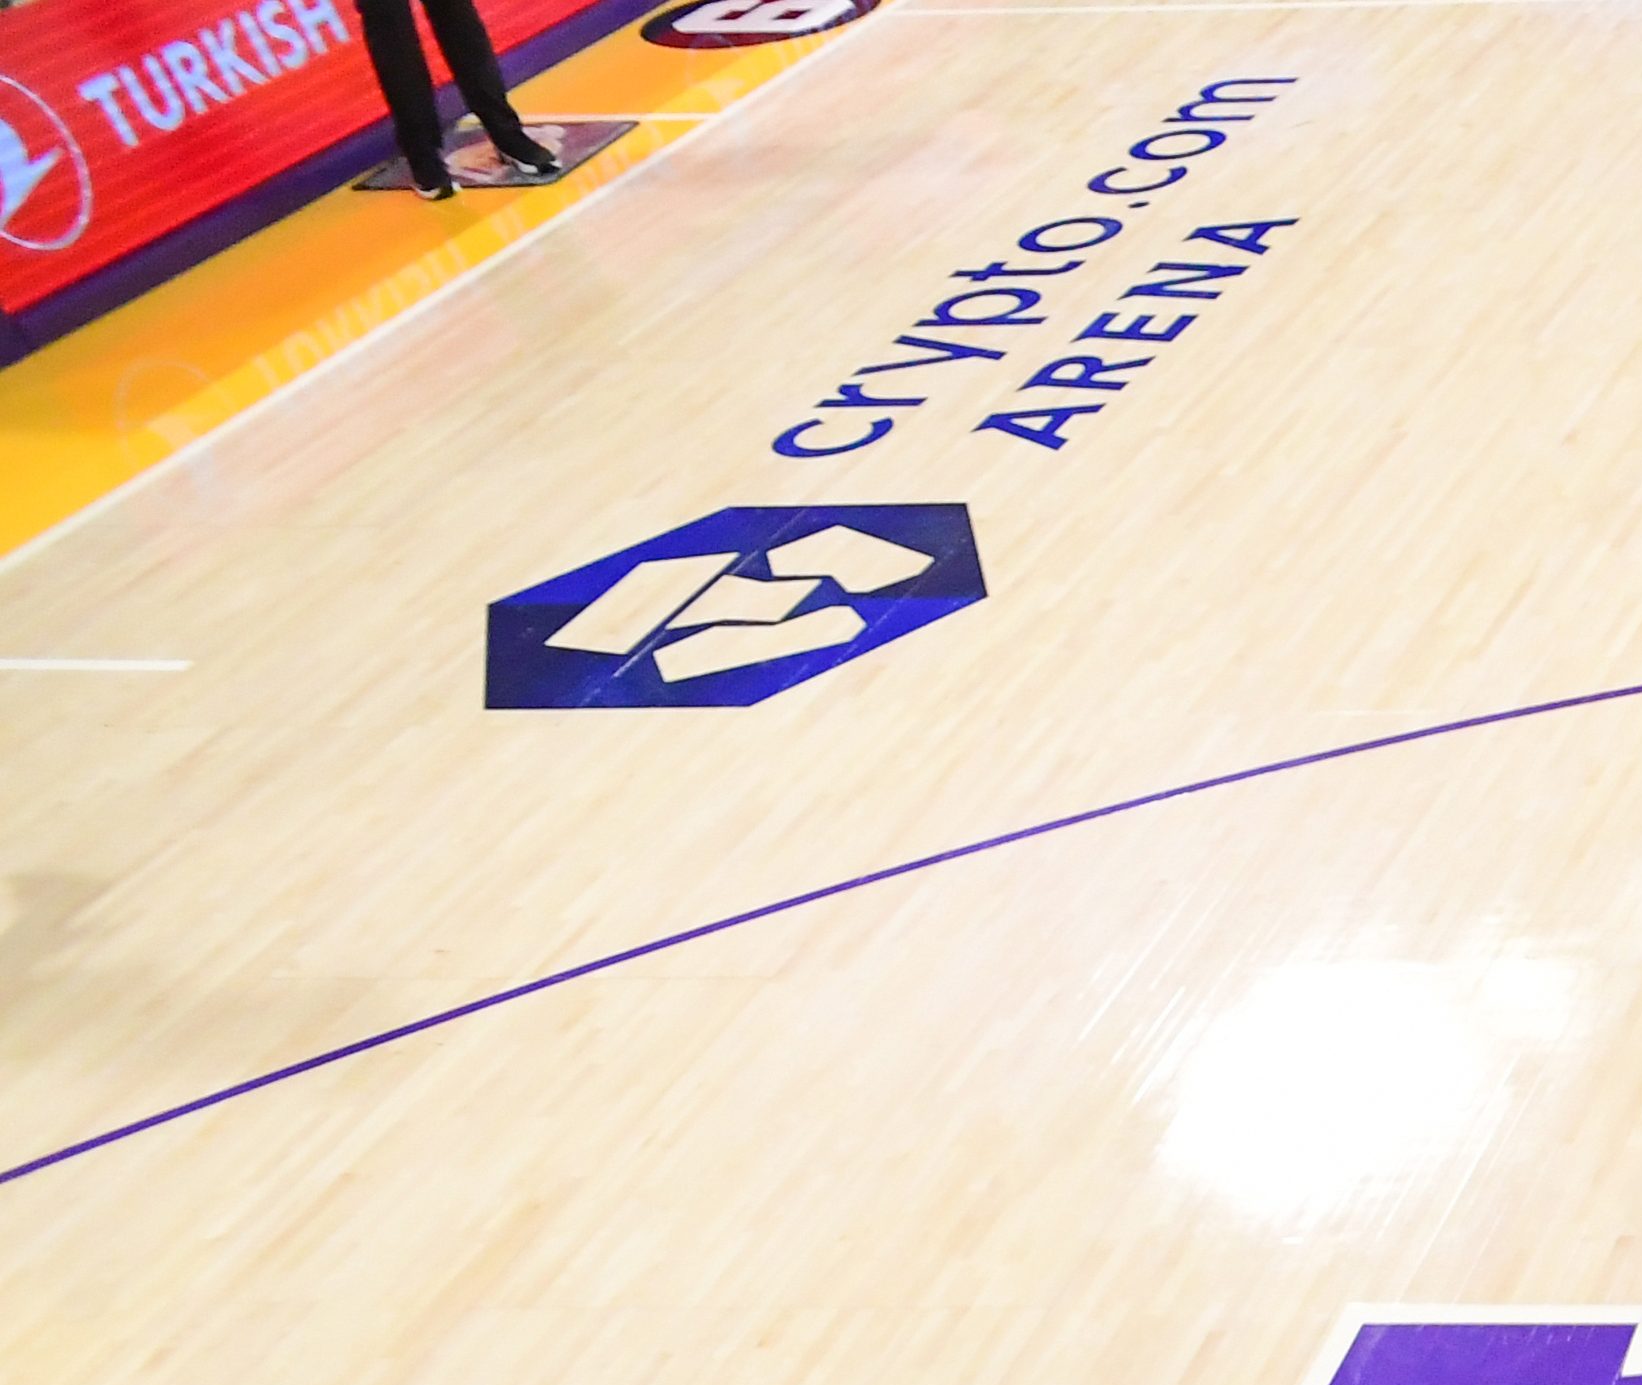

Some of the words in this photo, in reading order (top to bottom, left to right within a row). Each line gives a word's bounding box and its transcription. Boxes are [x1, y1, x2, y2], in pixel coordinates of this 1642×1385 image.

[77, 0, 350, 147] TURKISH
[771, 77, 1300, 458] crypto.com
[970, 217, 1301, 451] ARENA
